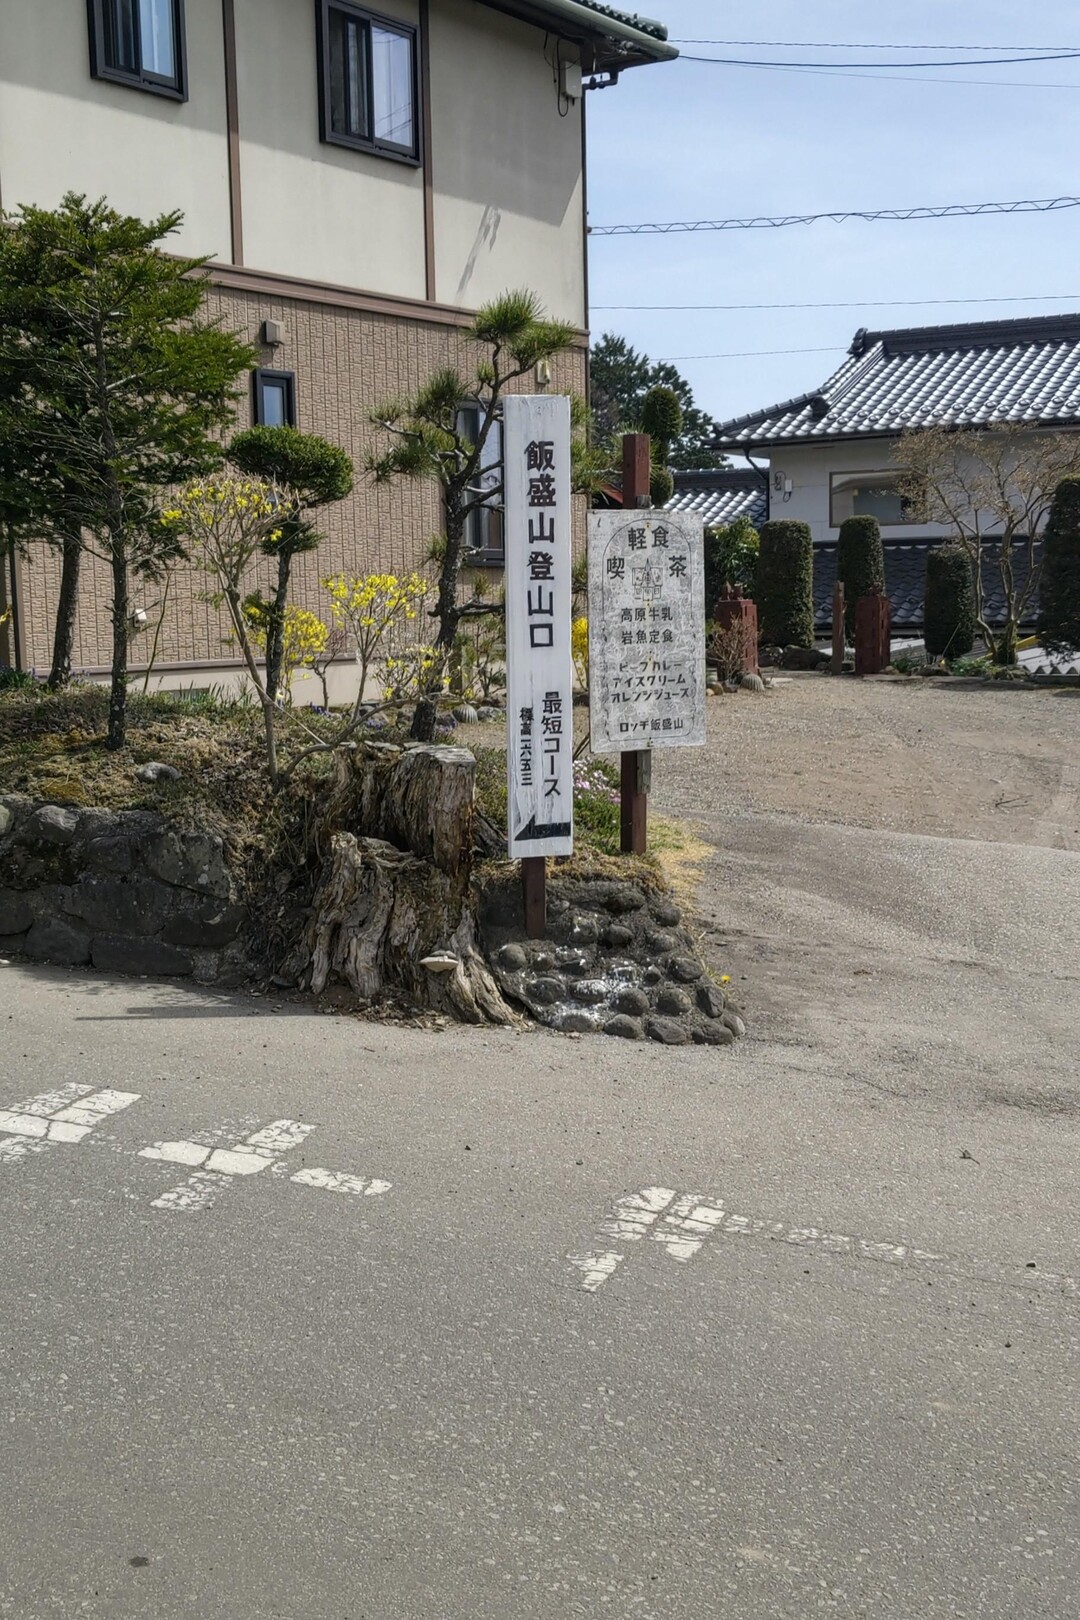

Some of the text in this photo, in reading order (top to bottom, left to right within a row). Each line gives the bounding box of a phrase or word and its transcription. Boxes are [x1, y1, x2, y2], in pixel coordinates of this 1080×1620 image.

[524, 440, 557, 648] 飯盛山登山口
[627, 525, 669, 551] 軽食
[620, 607, 673, 622] 高原牛乳
[621, 629, 674, 645] 岩魚定食
[612, 673, 686, 688] アイスクリーム
[610, 688, 690, 703] オレンジジュース
[541, 691, 563, 797] 最短コース
